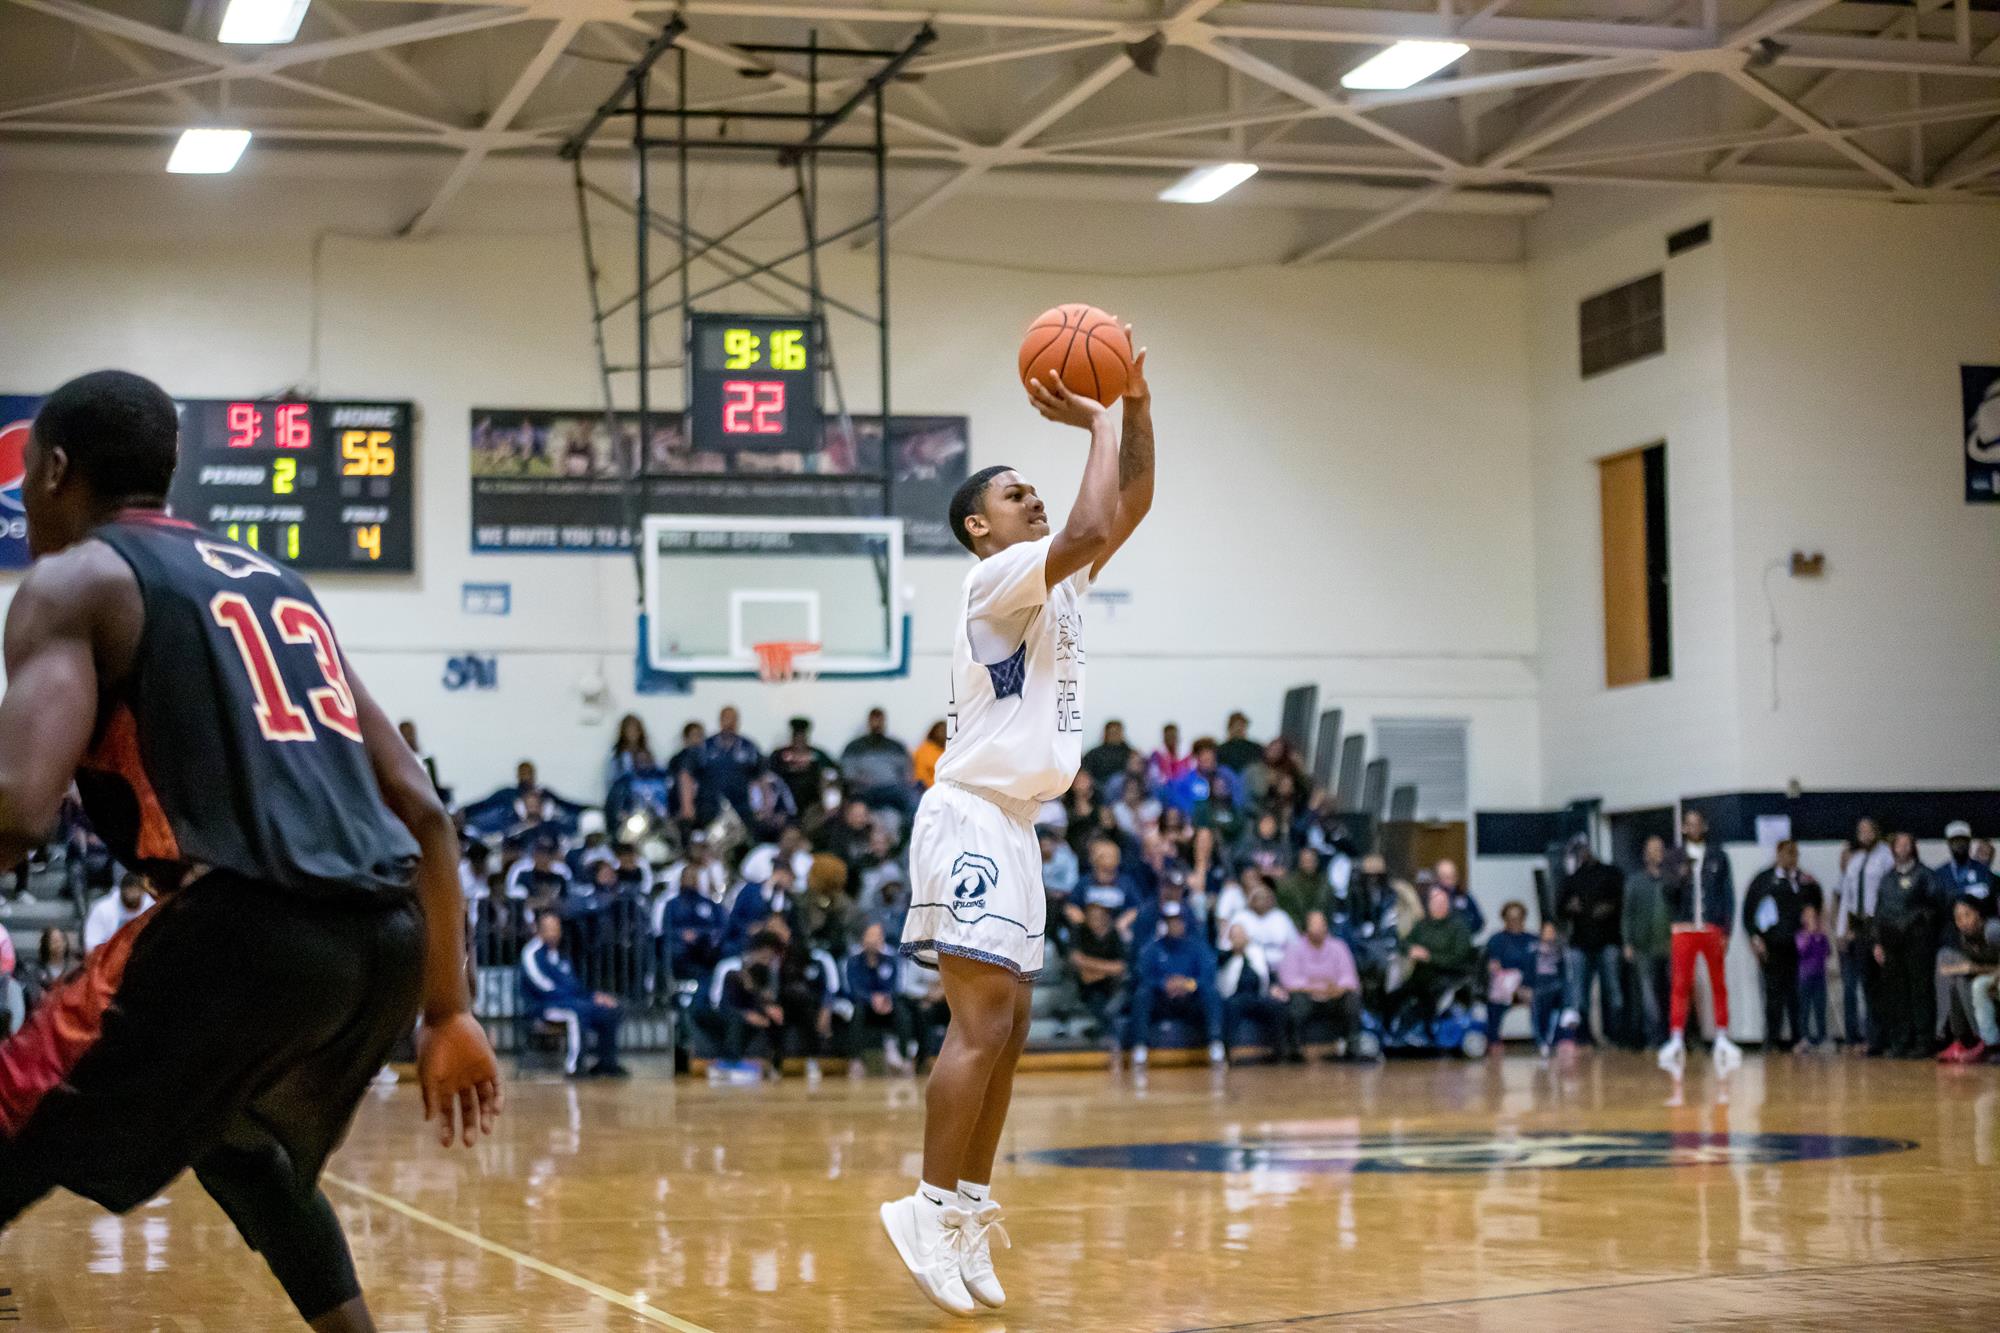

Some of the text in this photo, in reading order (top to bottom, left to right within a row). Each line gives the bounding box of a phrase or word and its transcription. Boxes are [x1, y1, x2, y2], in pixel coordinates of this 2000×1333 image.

[724, 329, 806, 370] 9:16
[228, 403, 311, 448] 9:16
[723, 381, 785, 433] 22
[273, 458, 296, 494] 2
[342, 431, 395, 476] 56
[357, 524, 380, 560] 4
[210, 591, 364, 743] 13
